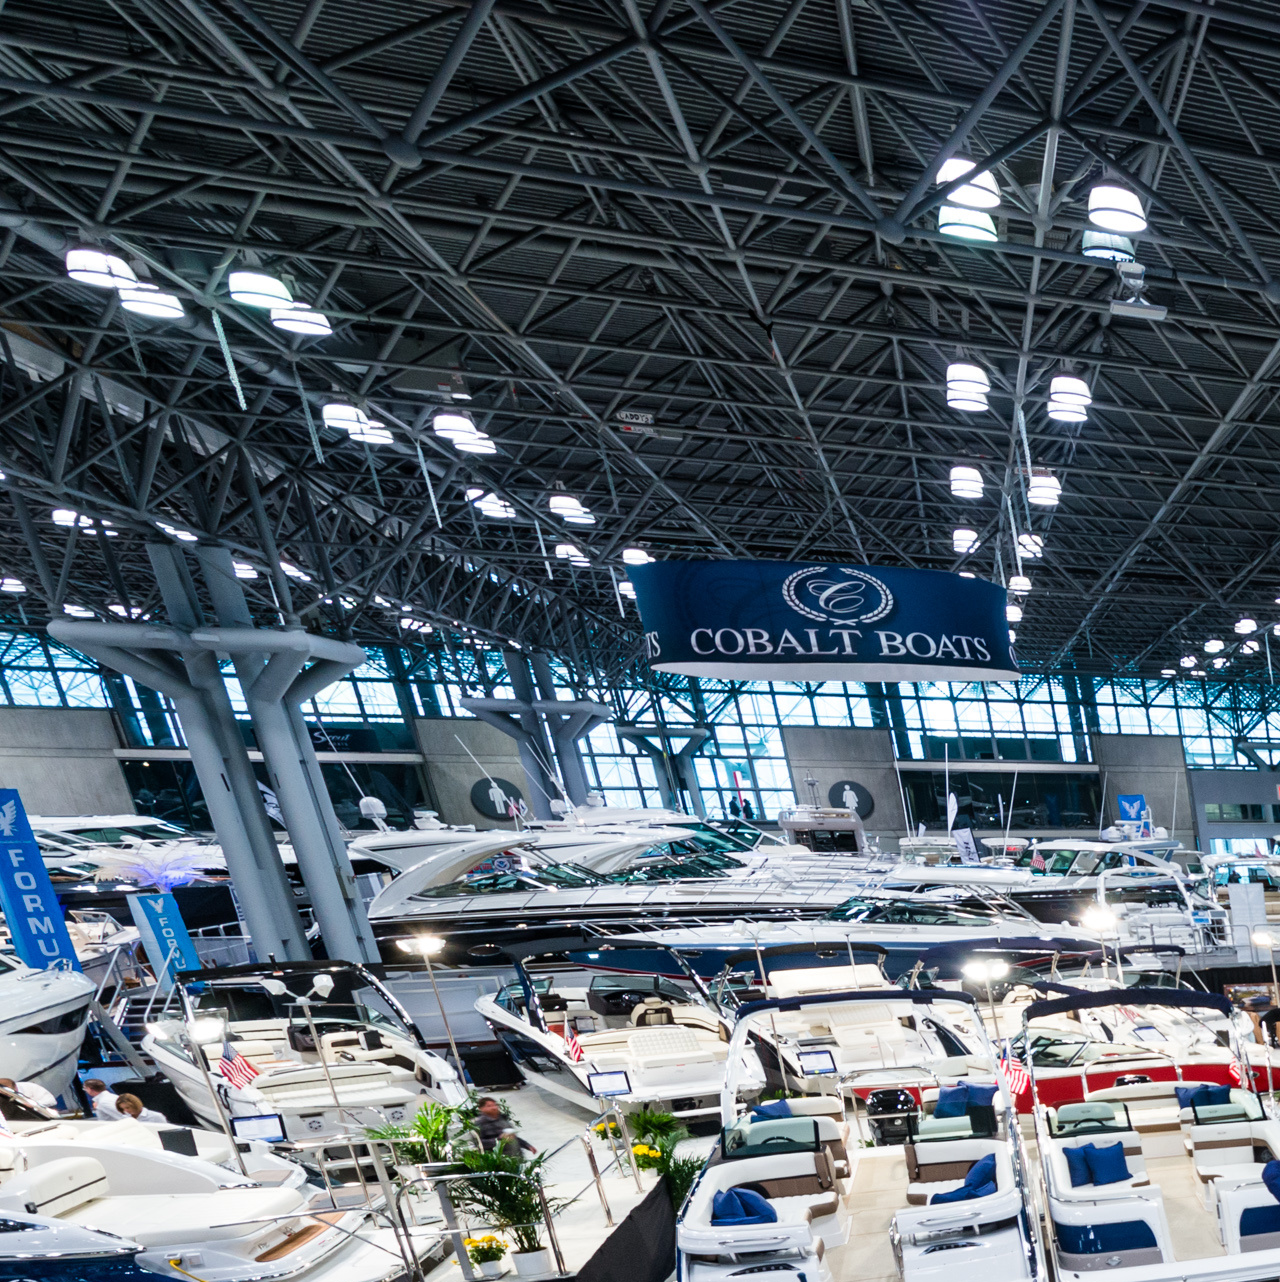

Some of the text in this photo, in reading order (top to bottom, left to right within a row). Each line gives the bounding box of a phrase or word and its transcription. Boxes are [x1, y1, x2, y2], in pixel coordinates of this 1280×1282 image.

[690, 627, 863, 656] COBALT
[874, 630, 992, 662] BOATS
[7, 849, 60, 964] FORMU
